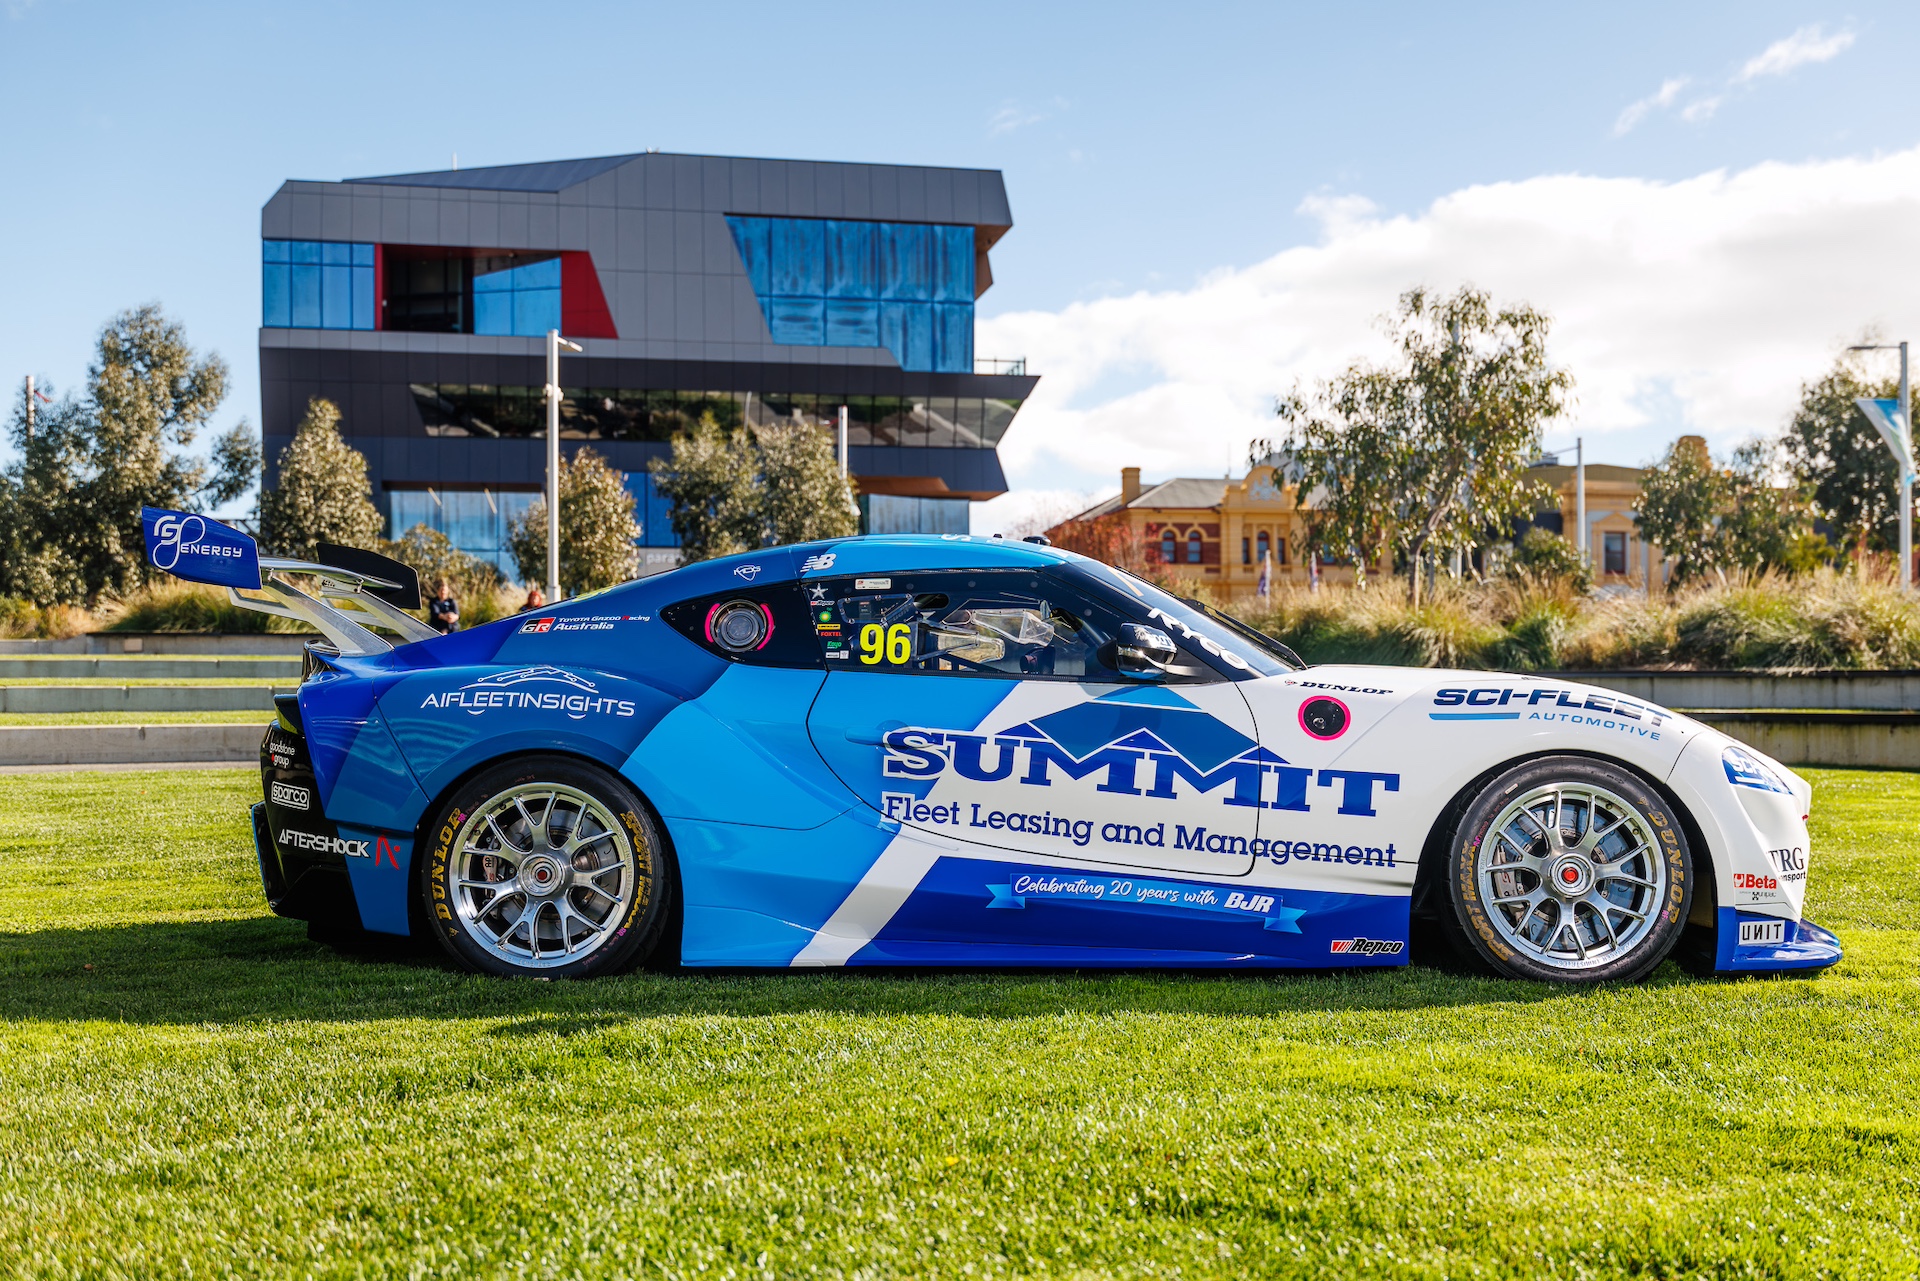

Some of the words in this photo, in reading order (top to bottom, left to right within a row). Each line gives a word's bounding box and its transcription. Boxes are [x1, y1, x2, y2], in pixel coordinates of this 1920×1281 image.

[180, 543, 243, 558] ENERGY
[553, 621, 614, 631] Australia
[859, 623, 911, 665] 96
[1299, 680, 1394, 696] DUNLOP
[420, 691, 636, 717] AIFLEETINSIGHTS
[1433, 688, 1673, 728] SCI-FLEET
[1528, 711, 1661, 741] AUTOMOTIVE
[269, 740, 296, 756] goodstone
[273, 755, 290, 769] group
[883, 727, 1400, 817] SUMMIT
[272, 784, 308, 804] sparco
[278, 828, 371, 858] AFTERSHOCK
[620, 810, 653, 875] SPORT
[885, 795, 961, 826] Fleet
[969, 803, 1094, 847] Leasing
[1101, 822, 1165, 848] and
[1173, 824, 1397, 868] Management
[431, 807, 461, 921] DUNLOP
[1459, 839, 1477, 902] MAXX
[1647, 811, 1685, 924] DUNLOP
[1767, 846, 1805, 873] TRG
[1745, 873, 1777, 890] Beta
[1778, 871, 1807, 884] nsport
[1014, 874, 1106, 900] Celebrating
[1109, 880, 1133, 897] 20
[1136, 884, 1179, 903] years
[1184, 888, 1219, 906] with
[1223, 892, 1275, 913] BJR
[1347, 936, 1405, 957] Repco
[1466, 903, 1515, 962] SPORT
